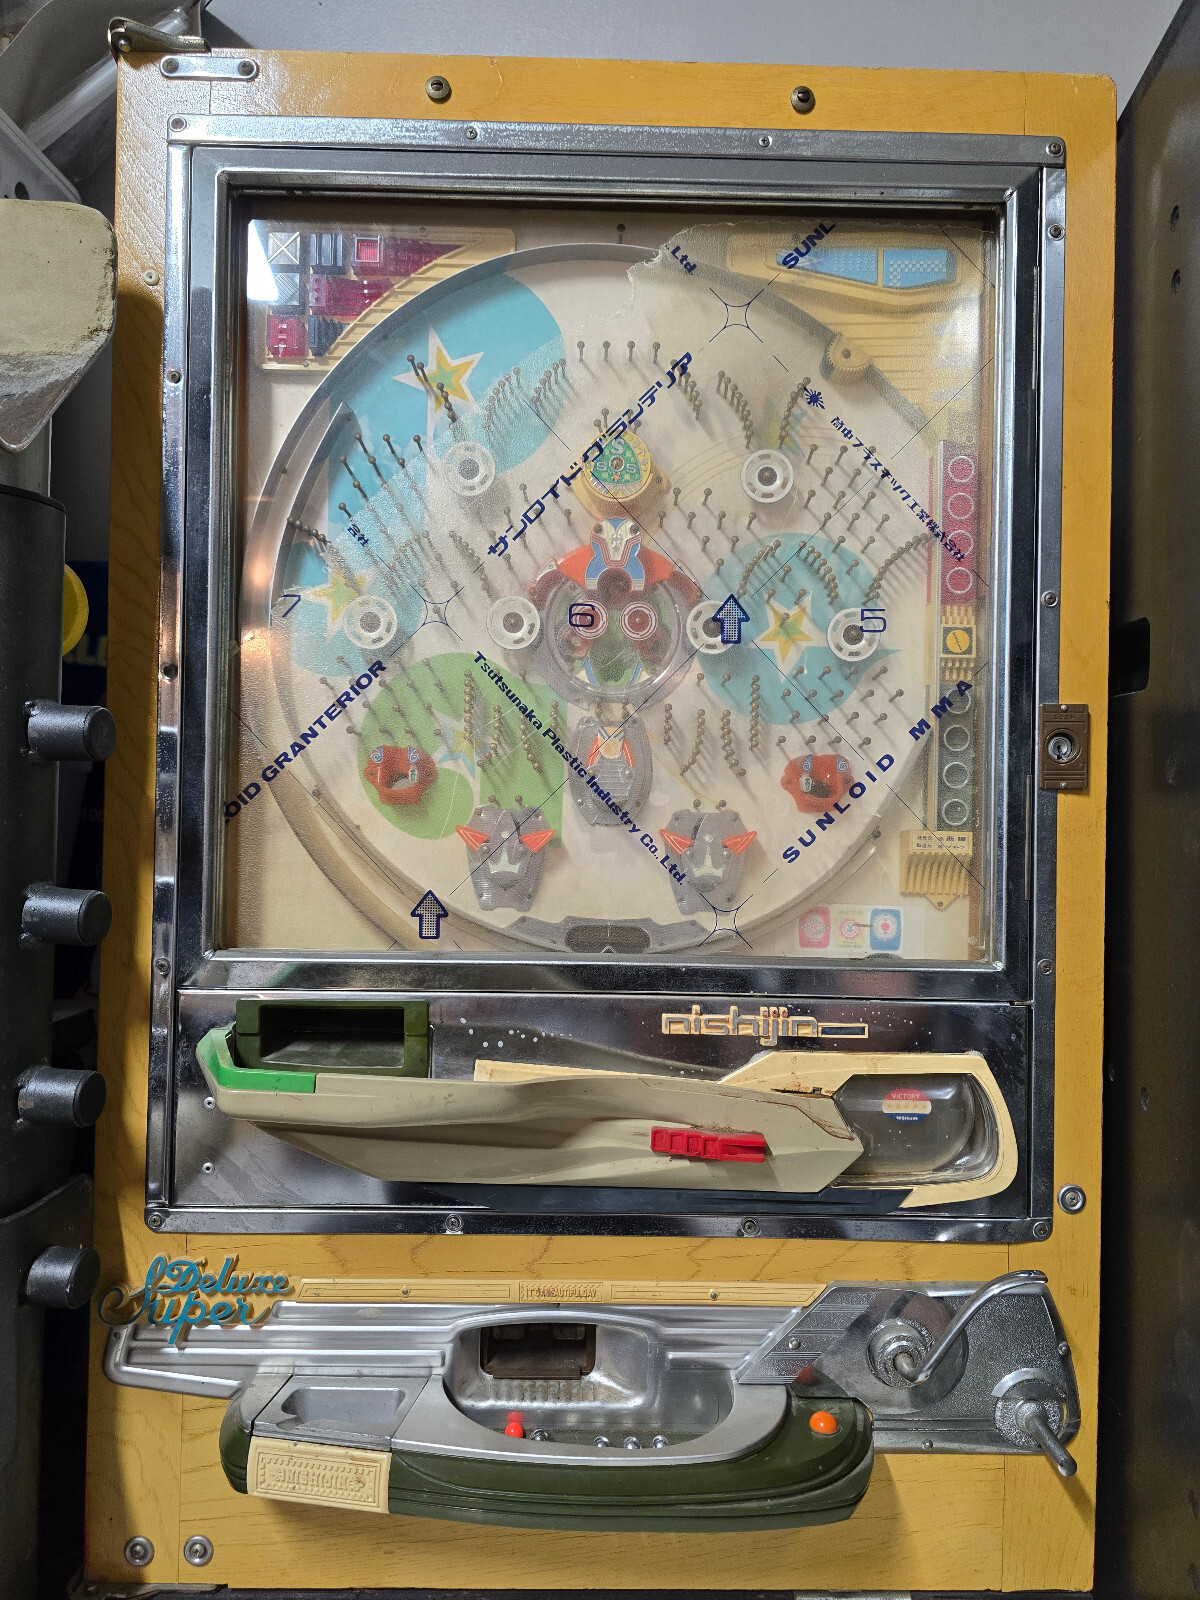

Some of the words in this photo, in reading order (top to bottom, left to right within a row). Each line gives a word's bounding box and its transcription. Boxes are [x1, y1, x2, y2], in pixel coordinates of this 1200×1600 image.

[670, 245, 697, 275] Ltd.
[782, 222, 836, 269] SUNL
[568, 602, 595, 628] 6
[859, 608, 887, 633] 5
[261, 659, 388, 783] GRANTERIOR
[473, 651, 544, 732] Tsutsunaka
[544, 725, 588, 778] Plastic
[586, 769, 640, 837] Industry
[660, 853, 686, 886] Ltd.
[782, 753, 896, 864] SUNLOID
[662, 1004, 818, 1046] nishijin
[155, 1255, 294, 1295] Deluxe
[97, 1253, 271, 1345] Super
